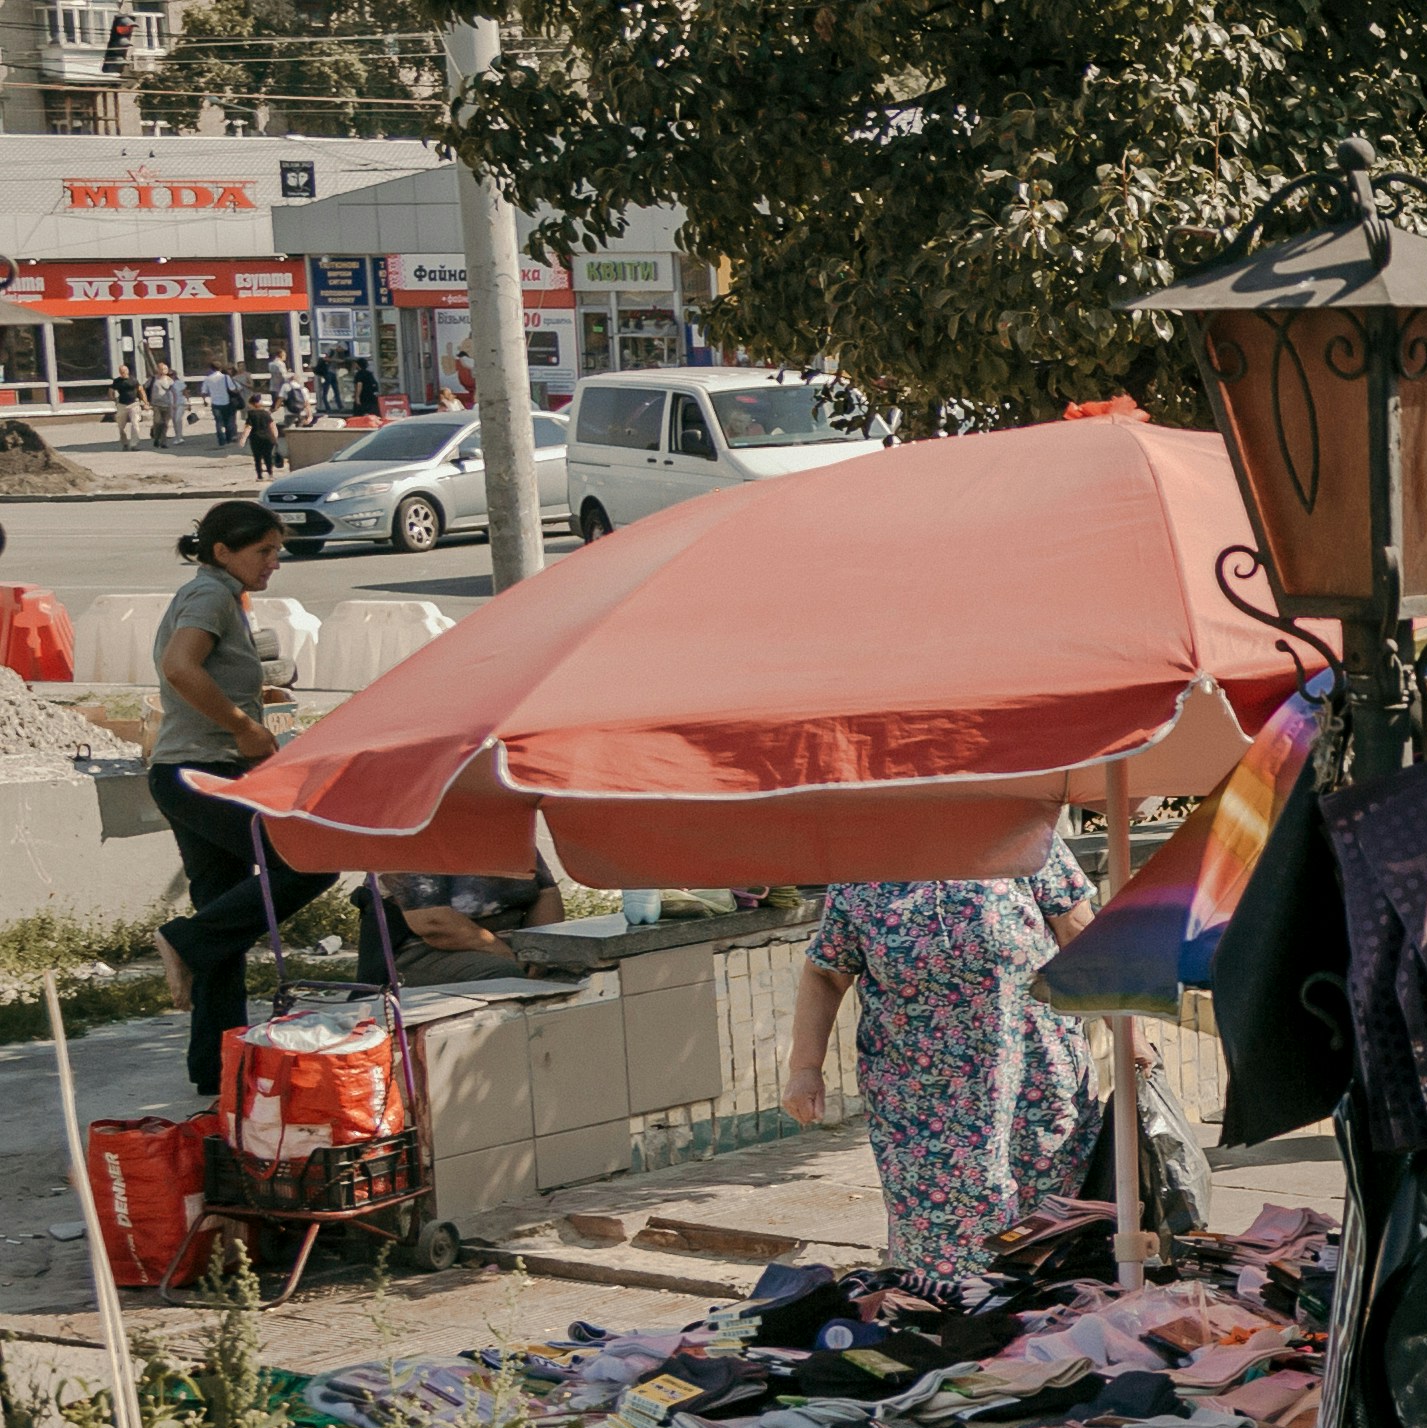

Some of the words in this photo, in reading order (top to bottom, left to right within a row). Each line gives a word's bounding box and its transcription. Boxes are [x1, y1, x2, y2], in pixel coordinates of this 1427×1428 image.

[64, 186, 256, 208] MIDA
[413, 265, 467, 283] Файна
[586, 260, 658, 282] КВІТИ
[66, 279, 216, 300] MIDA
[104, 1151, 132, 1228] DENNER
